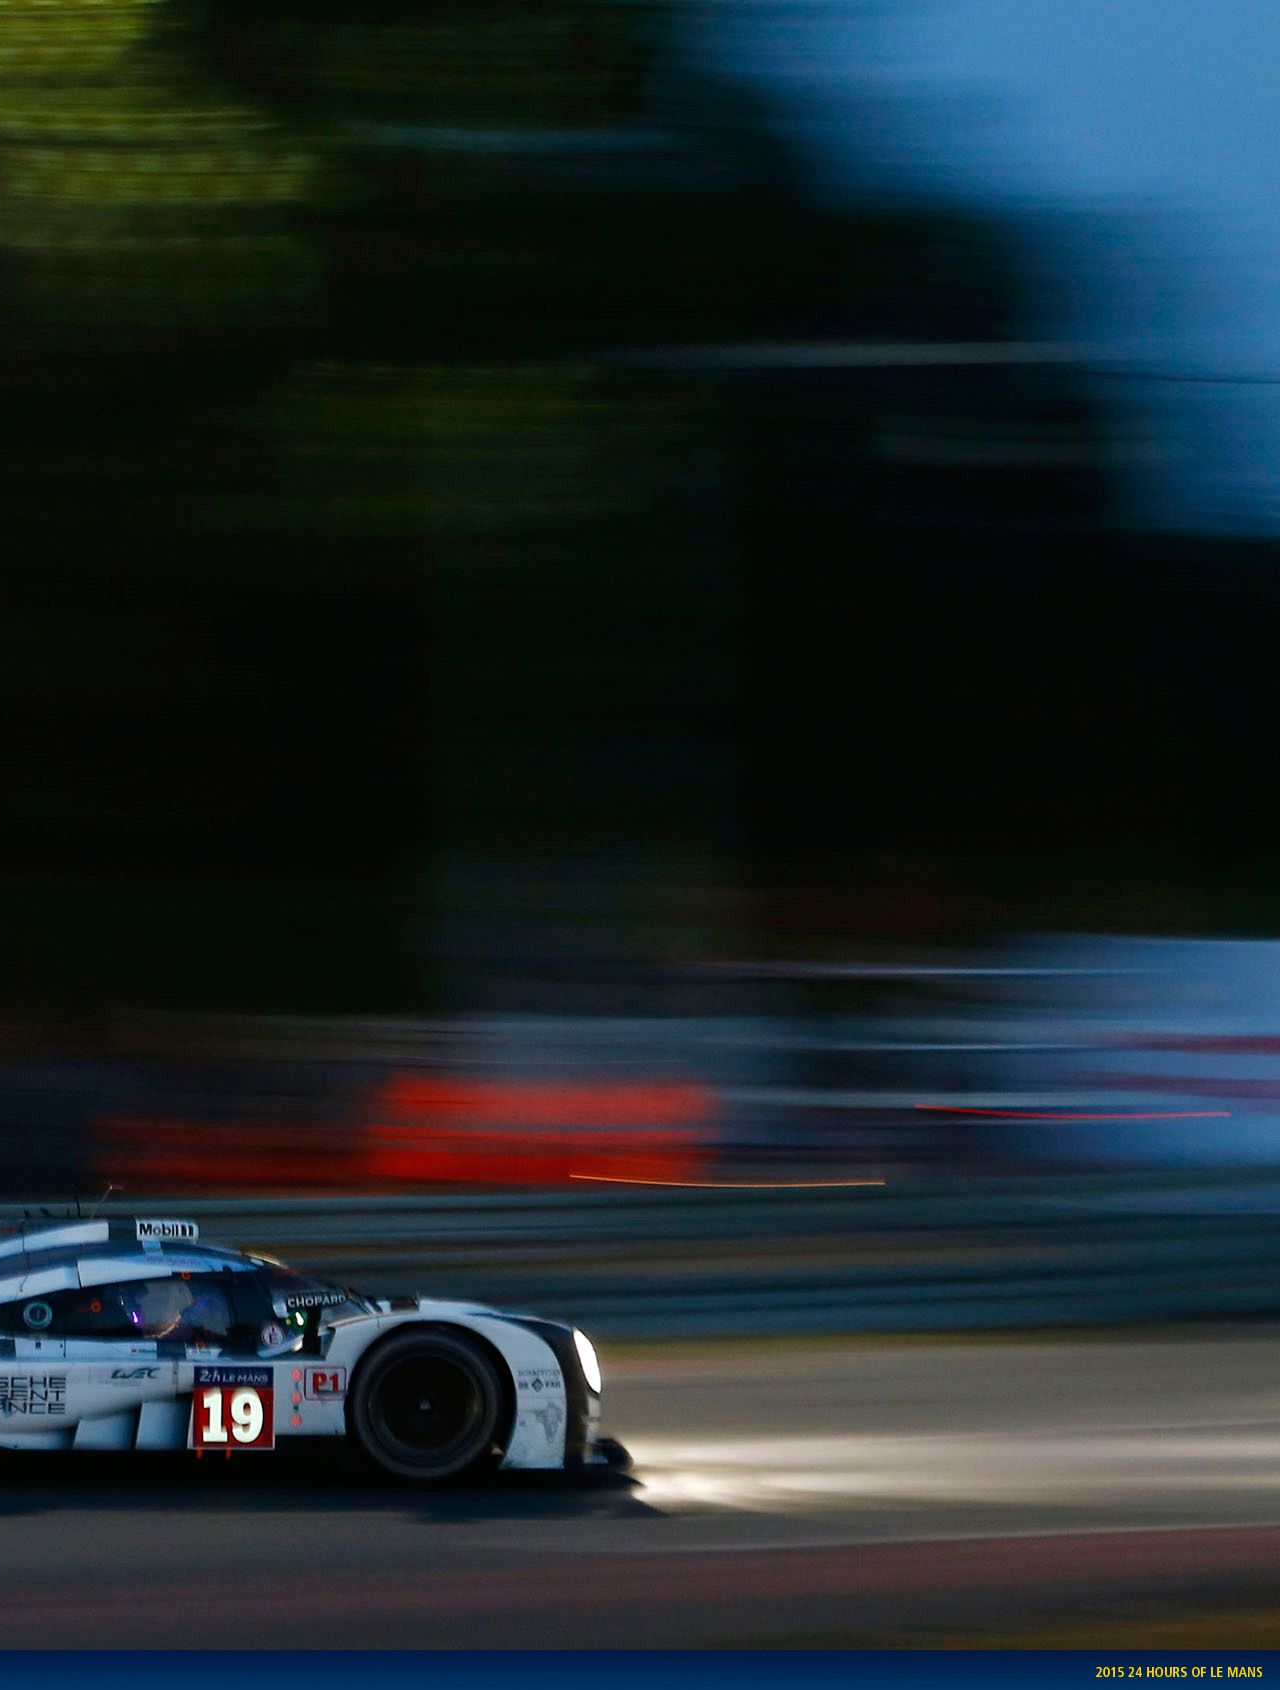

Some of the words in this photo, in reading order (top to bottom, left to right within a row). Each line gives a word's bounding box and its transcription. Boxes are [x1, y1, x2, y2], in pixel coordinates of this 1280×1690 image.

[139, 1223, 179, 1237] Mobil
[287, 1294, 346, 1308] CHOPARD
[312, 1372, 339, 1393] P1
[202, 1387, 264, 1443] 19
